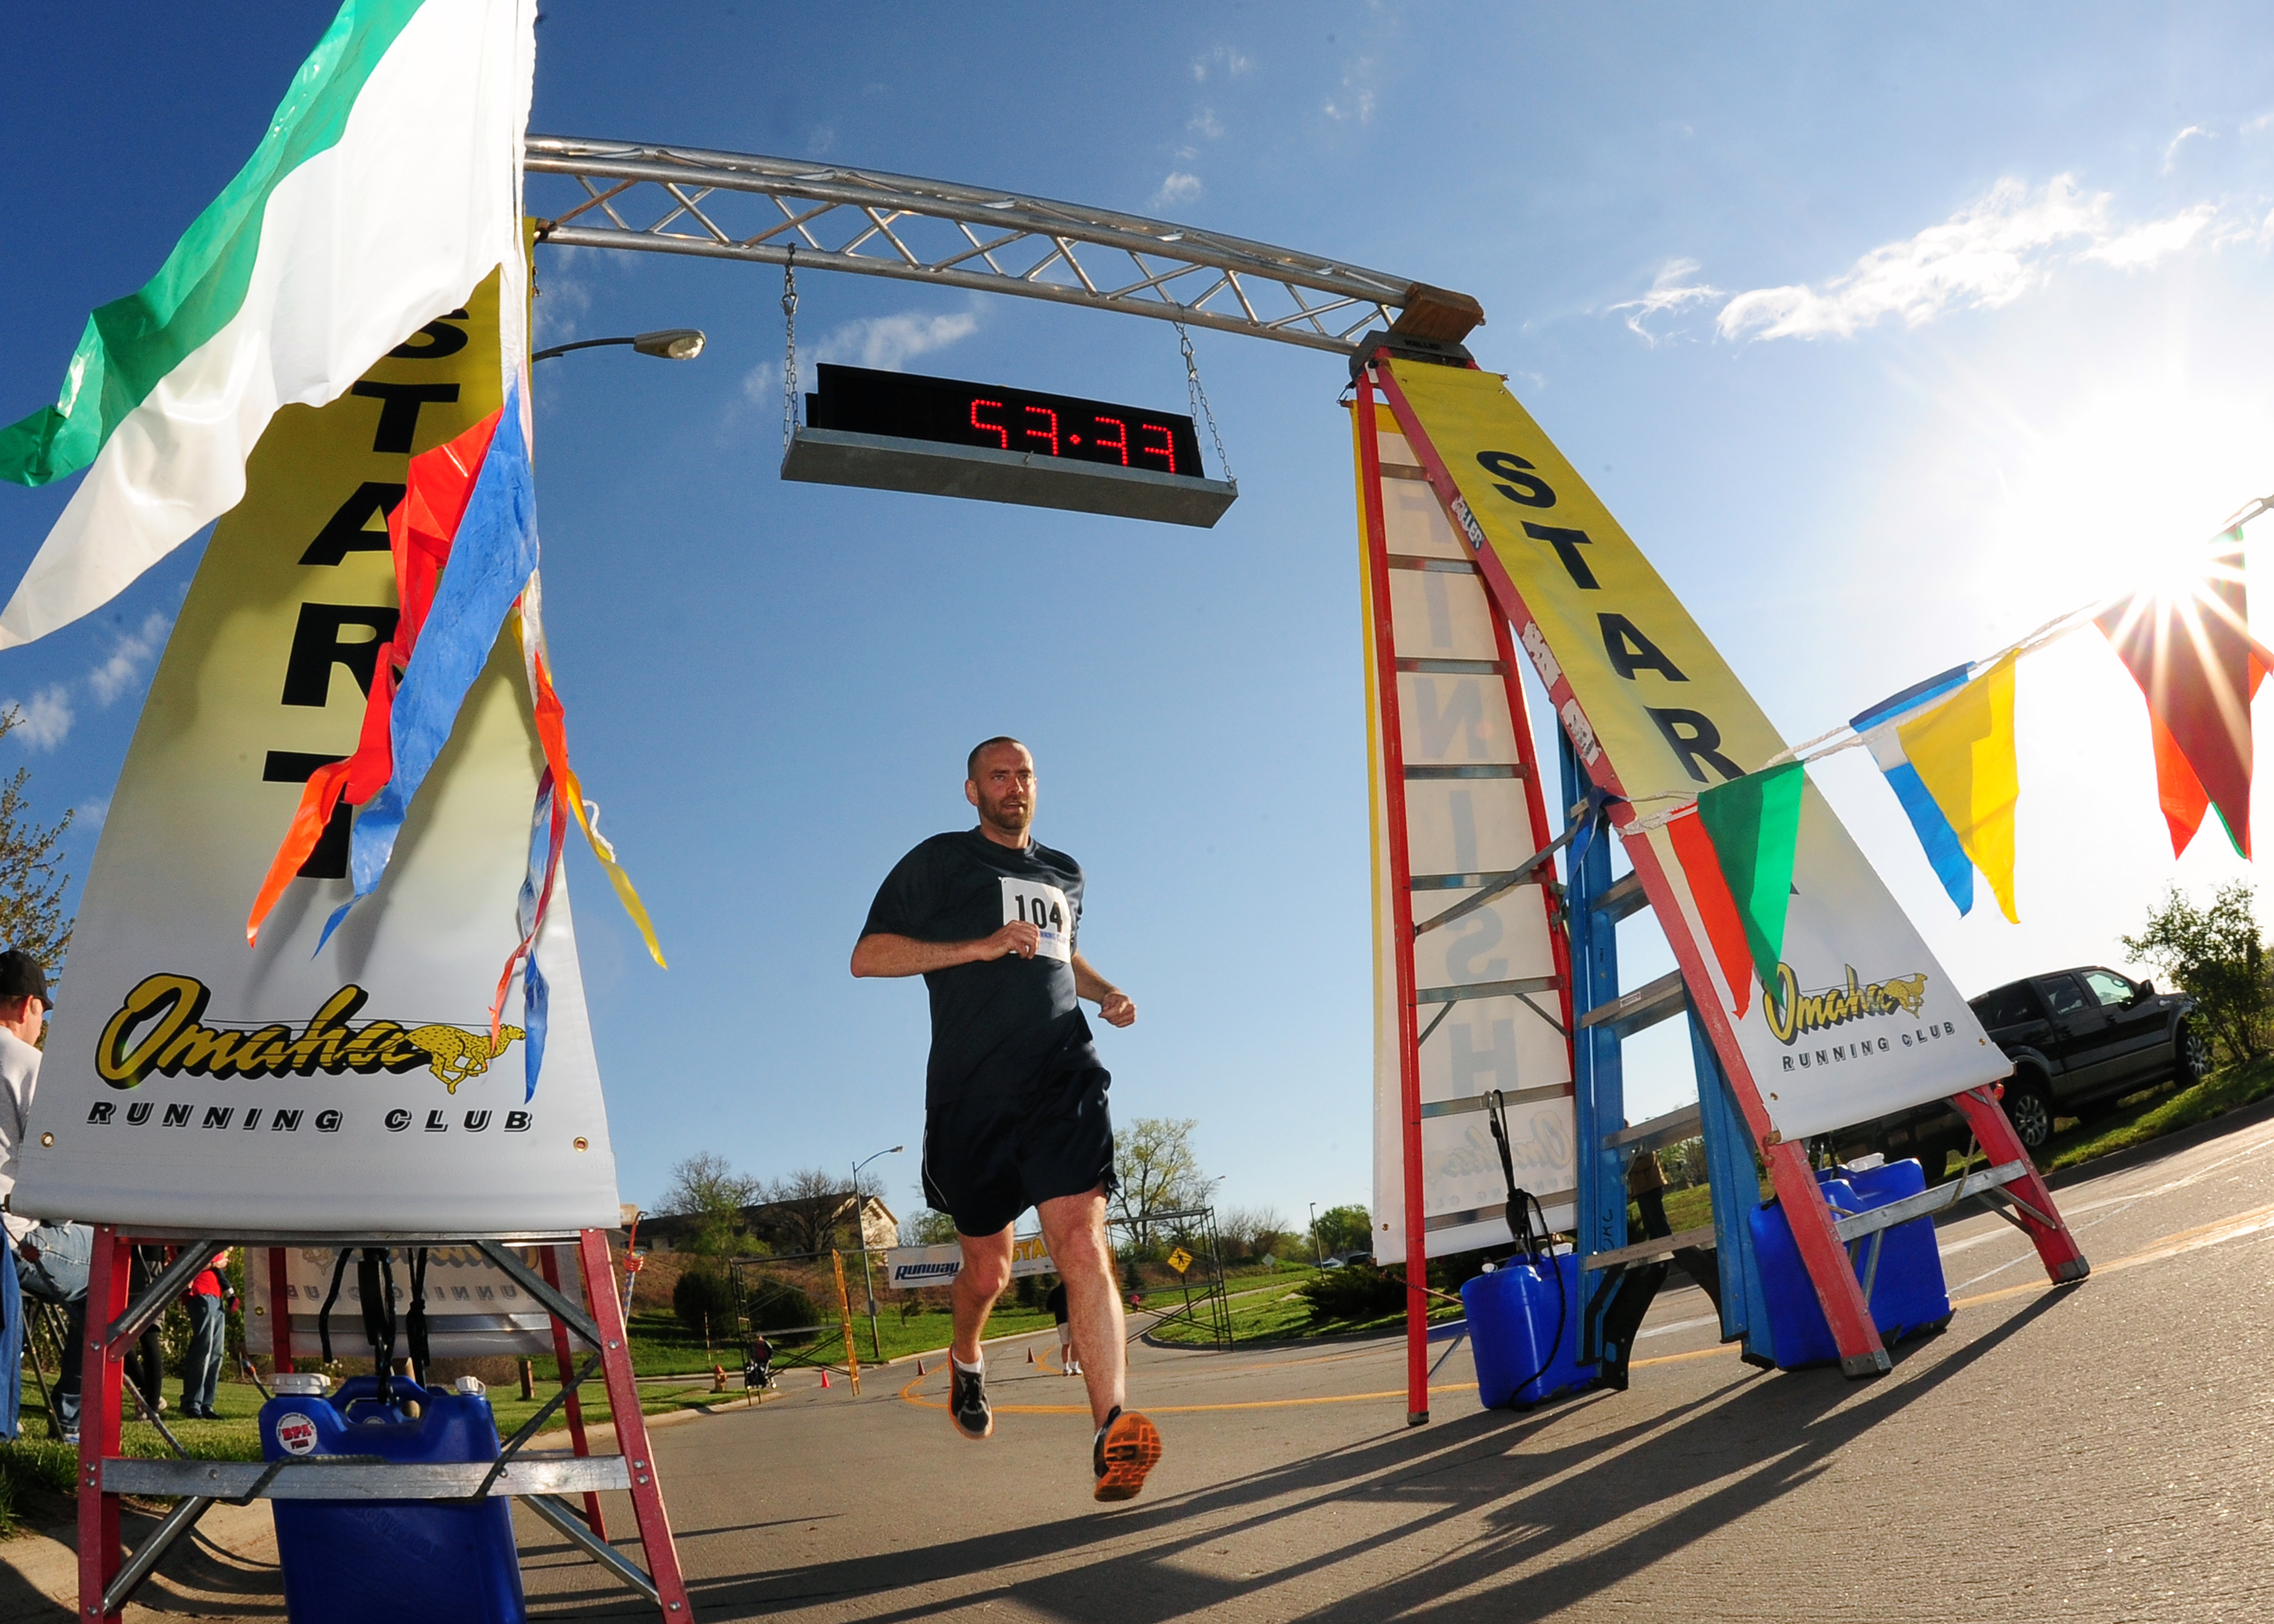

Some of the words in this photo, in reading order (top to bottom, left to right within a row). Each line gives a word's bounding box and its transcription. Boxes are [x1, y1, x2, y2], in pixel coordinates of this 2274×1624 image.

[1476, 451, 1800, 895] STAR
[1015, 895, 1062, 933] 104
[1763, 962, 1901, 1046] Omaha
[95, 972, 434, 1090] Omaha
[1782, 1037, 1890, 1072] RUNNING
[1901, 1021, 1955, 1047] CLUB
[87, 1101, 343, 1132] RUNNING
[384, 1108, 533, 1132] CLUB
[282, 1424, 312, 1442] BPA
